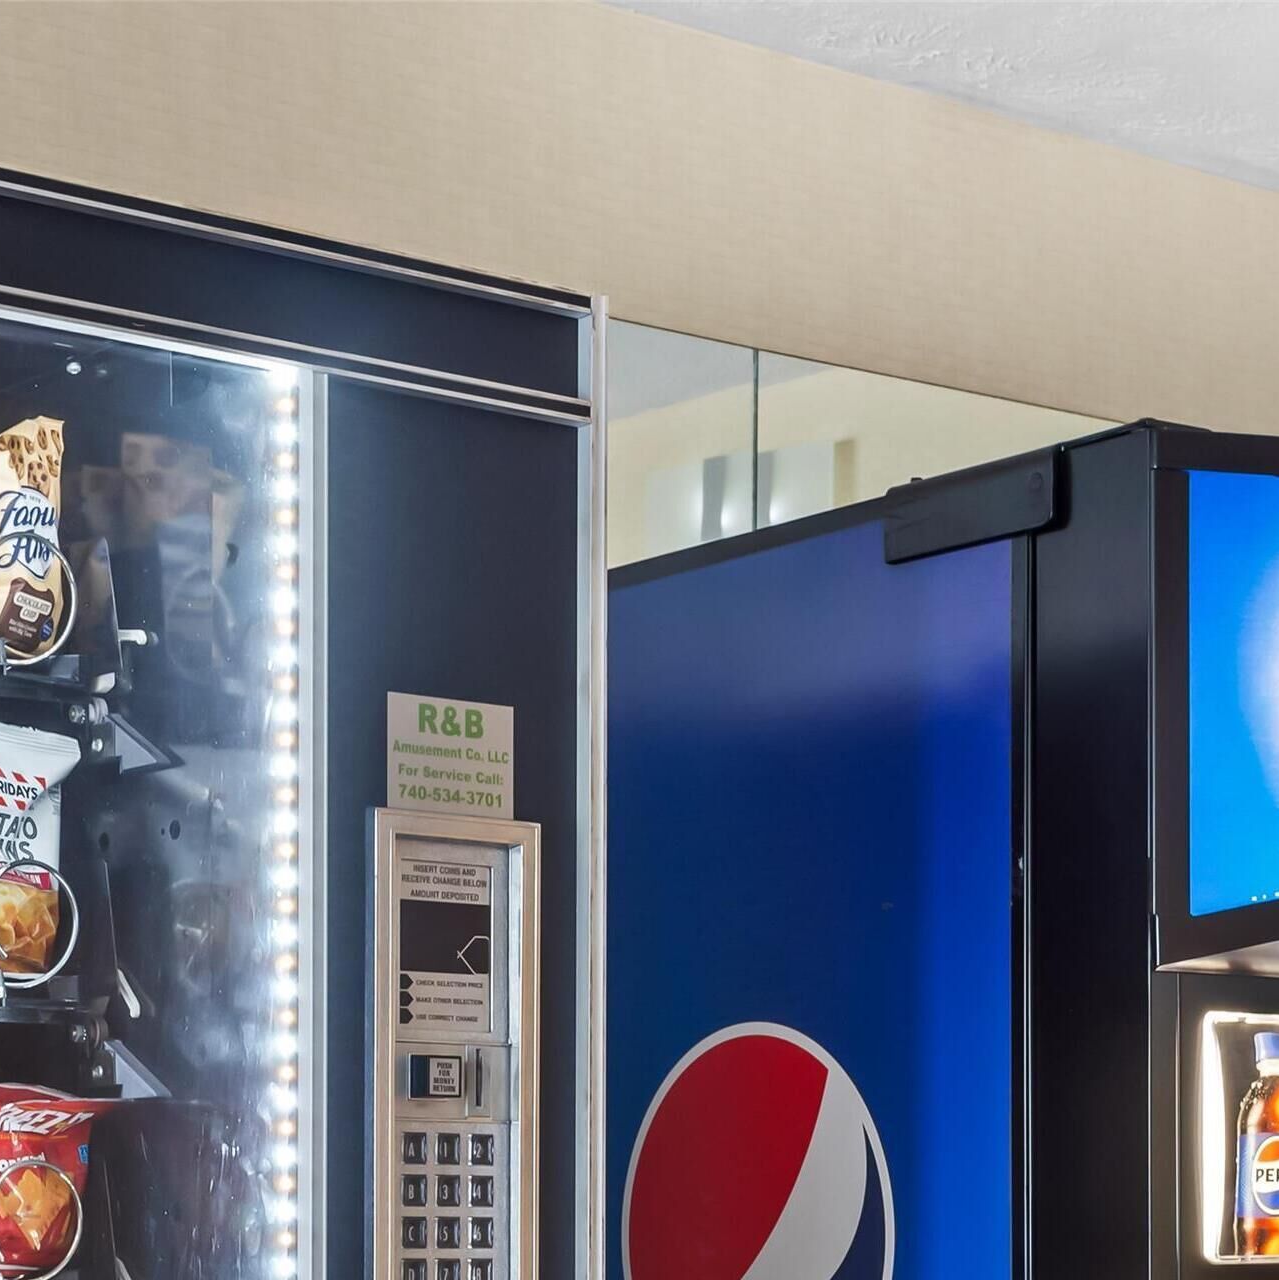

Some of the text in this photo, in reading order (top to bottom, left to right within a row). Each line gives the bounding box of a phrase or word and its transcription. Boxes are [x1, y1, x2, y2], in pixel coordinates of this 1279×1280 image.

[418, 702, 484, 739] R&B
[393, 739, 510, 764] Amusement Co. LLC
[398, 763, 504, 785] For Service Call:
[399, 783, 503, 808] 740-534-3701
[412, 864, 477, 877] INSERT COINS AND
[401, 874, 487, 888] RECEIVE CHANGE BELOW
[410, 889, 480, 902] AMOUNT DEPOSITED
[433, 1077, 455, 1085] MONEY
[433, 1085, 456, 1093] RETURN
[407, 1142, 415, 1157] A
[408, 1184, 415, 1199] B
[408, 1225, 415, 1241] C
